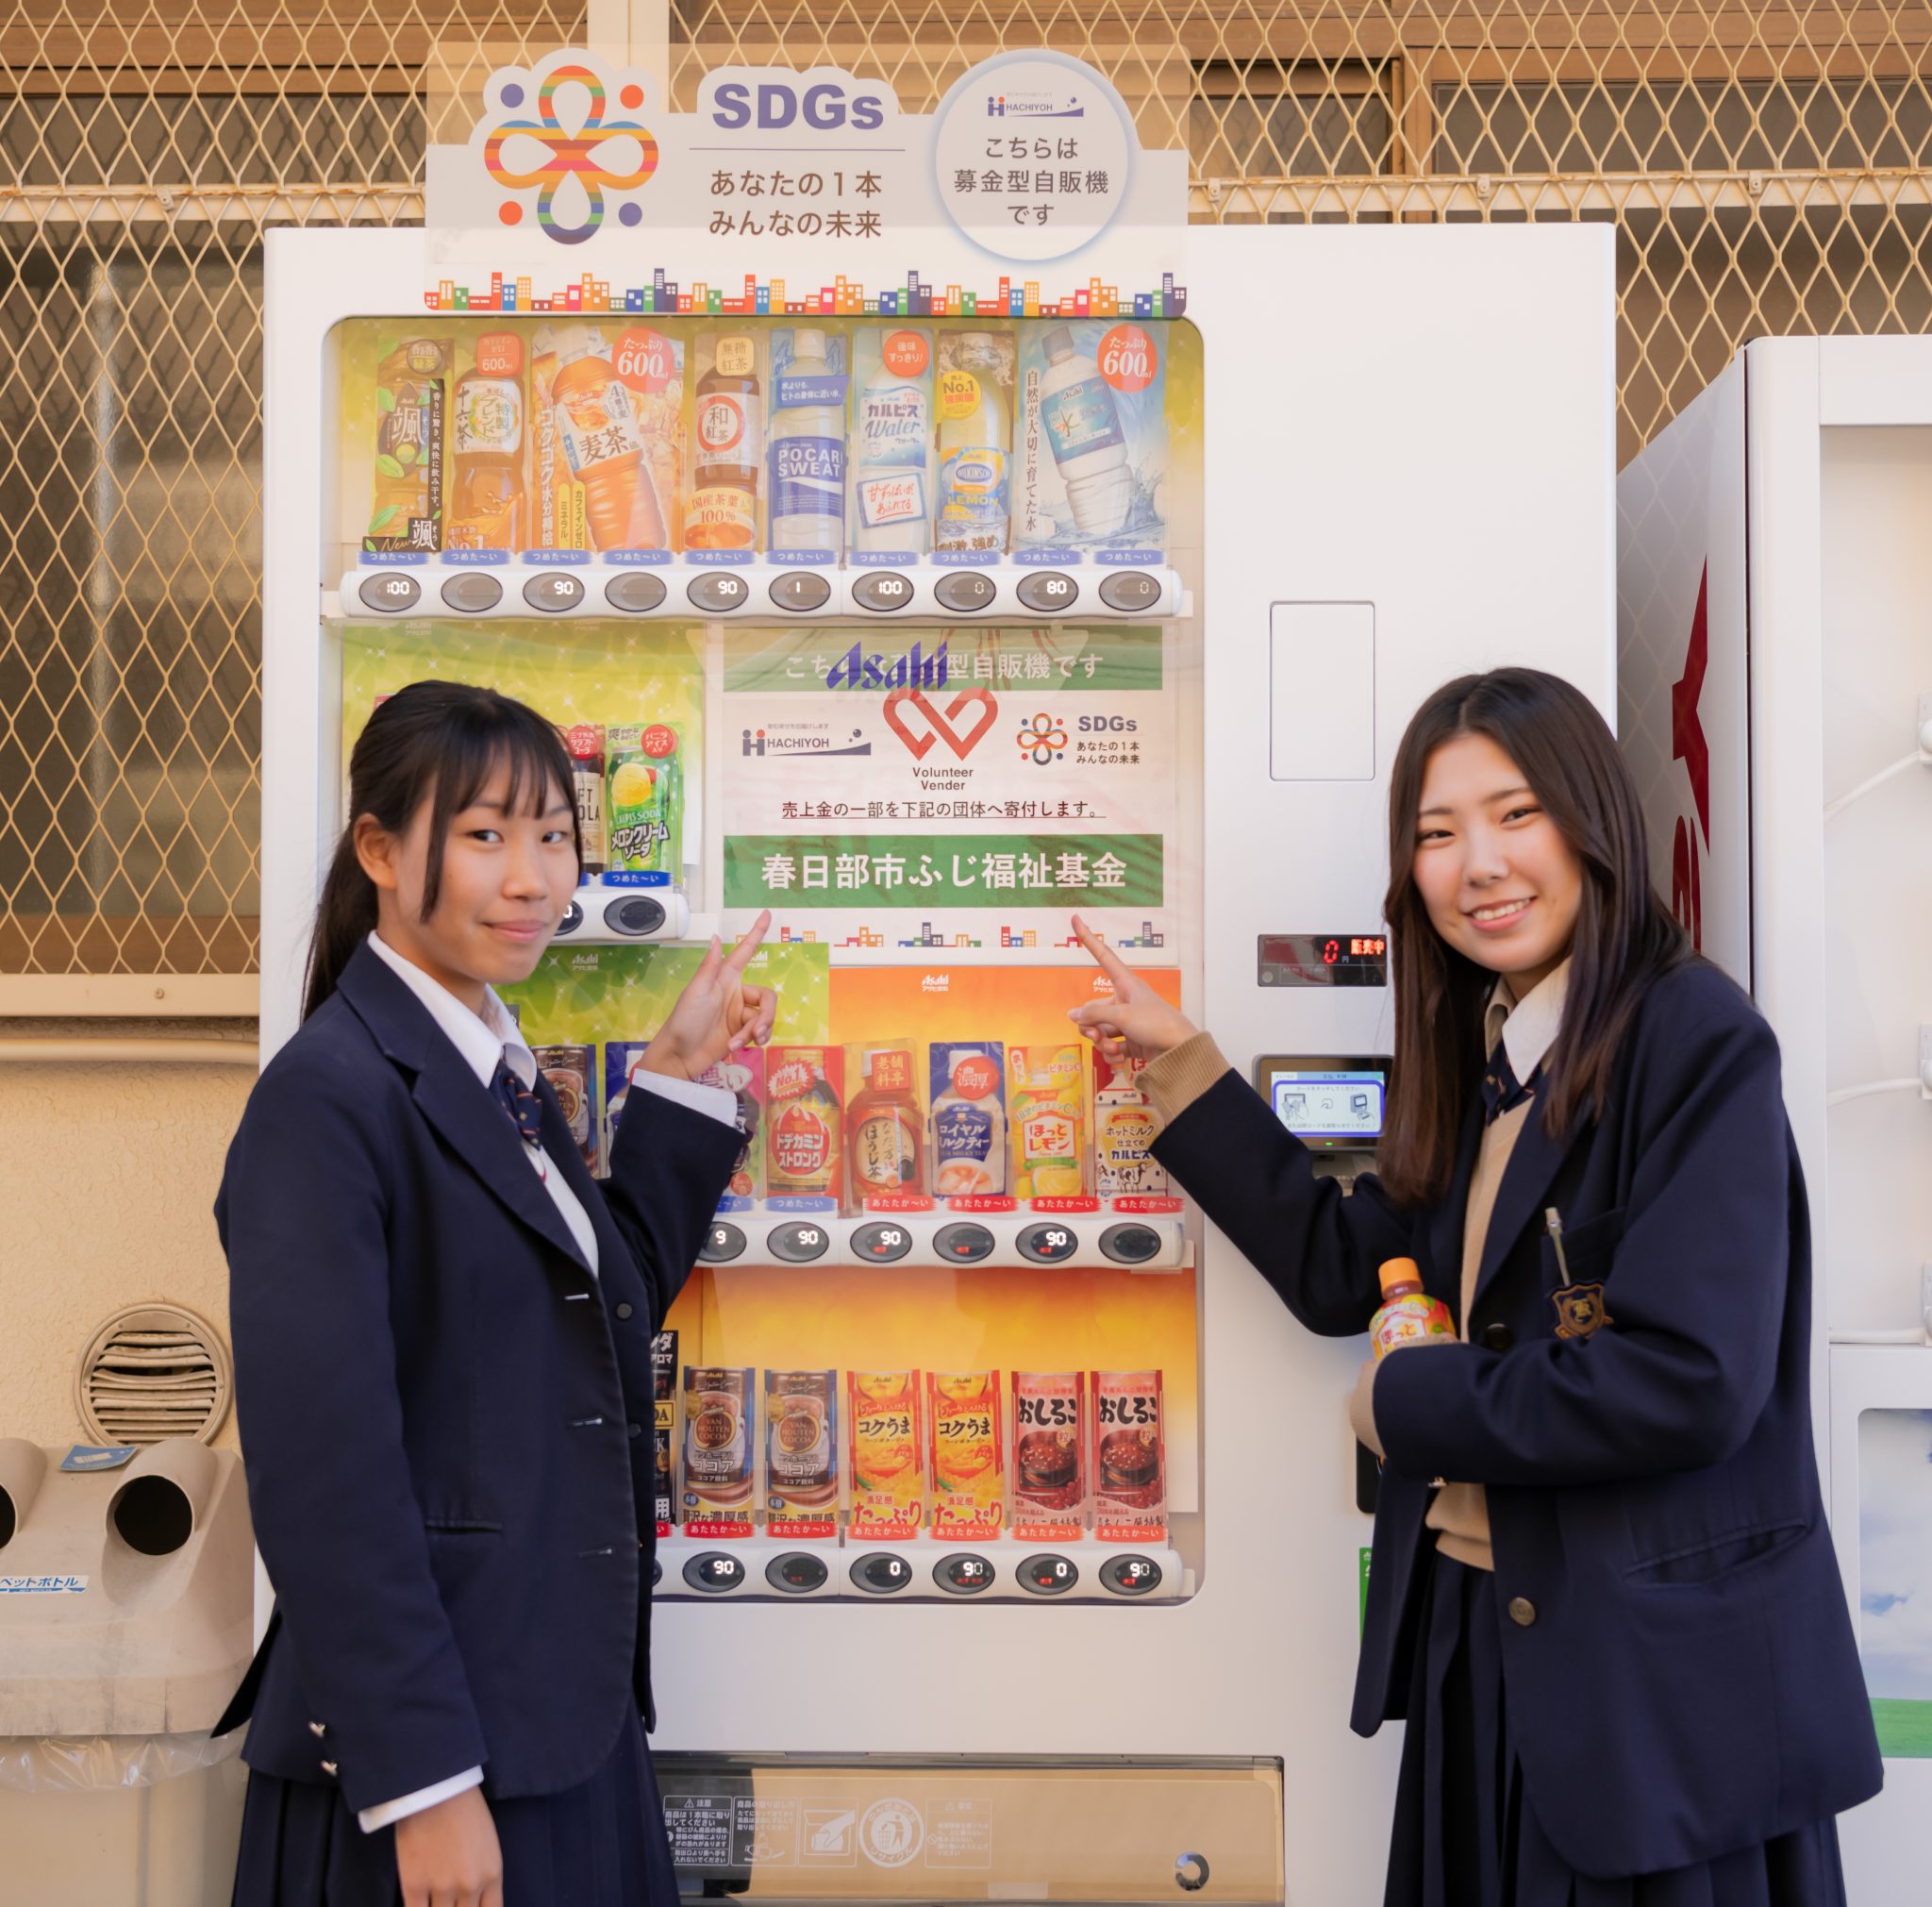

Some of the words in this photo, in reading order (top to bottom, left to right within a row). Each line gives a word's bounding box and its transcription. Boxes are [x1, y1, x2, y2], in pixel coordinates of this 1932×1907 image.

[712, 83, 884, 130] SDGs
[986, 137, 1078, 159] こちらは
[710, 170, 882, 198] あなたの1本
[954, 169, 1108, 194] 募金型自販機
[1008, 204, 1055, 226] です
[709, 209, 881, 238] みんなの未来
[624, 338, 663, 351] たっぷり
[722, 341, 746, 356] 無糖
[1109, 337, 1147, 350] たっぷり
[722, 357, 748, 372] 紅茶
[943, 380, 974, 394] No.1
[868, 404, 919, 419] カルピス
[865, 418, 921, 439] Water
[579, 425, 629, 466] 麦茶
[1025, 370, 1039, 533] 自然が大切に育てた水
[778, 448, 844, 465] POCARI
[778, 461, 840, 478] SWEAT
[947, 495, 999, 507] LEMON
[560, 500, 569, 539] ミネラル
[387, 580, 410, 595] 100
[554, 580, 575, 595] 90
[717, 580, 738, 595] 90
[878, 580, 903, 595] 100
[1046, 580, 1067, 595] 80
[785, 653, 1104, 680] こち型自販機です
[826, 642, 949, 690] Asahi
[1078, 716, 1138, 732] SDGs
[646, 739, 668, 747] アイス
[767, 738, 829, 748] HACHIYOH
[1076, 754, 1140, 765] みんなの未来
[912, 767, 974, 778] Volunteer
[921, 779, 966, 791] Vender
[578, 804, 601, 822] OLA
[782, 801, 1097, 818] 売上金の一部を下記の団体へ寄付します。
[611, 820, 669, 849] メロンクリーム
[625, 843, 651, 861] ソーダ
[761, 853, 1127, 890] 春日部市ふじ福祉基金
[572, 953, 599, 964] Asahi
[1324, 939, 1340, 963] 0
[922, 974, 949, 985] Asahi
[940, 1124, 987, 1138] ロイヤル
[1029, 1123, 1068, 1138] ほっと
[1106, 1125, 1155, 1137] ホットミルク
[776, 1133, 824, 1149] ドデカミン
[939, 1136, 990, 1150] ミルクティー
[1029, 1136, 1072, 1151] レモン
[1117, 1139, 1146, 1147] 仕立ての
[779, 1150, 823, 1168] ストロング
[865, 1125, 883, 1179] ほうじ茶
[1110, 1149, 1152, 1162] カルピス
[798, 1230, 819, 1245] 90
[880, 1230, 901, 1246] 90
[1045, 1231, 1067, 1246] 90
[858, 1415, 911, 1437] コクうま
[938, 1416, 991, 1438] コクうま
[698, 1433, 727, 1442] COCOA
[692, 1460, 735, 1474] ココア
[777, 1464, 820, 1477] ココア
[866, 1495, 894, 1505] 満足感
[946, 1497, 975, 1506] 満足感
[714, 1561, 734, 1575] 90
[890, 1562, 901, 1576] 0
[963, 1562, 983, 1576] 90
[1056, 1563, 1067, 1577] 0
[1129, 1563, 1150, 1577] 90
[0, 1577, 78, 1587] ペットボトル
